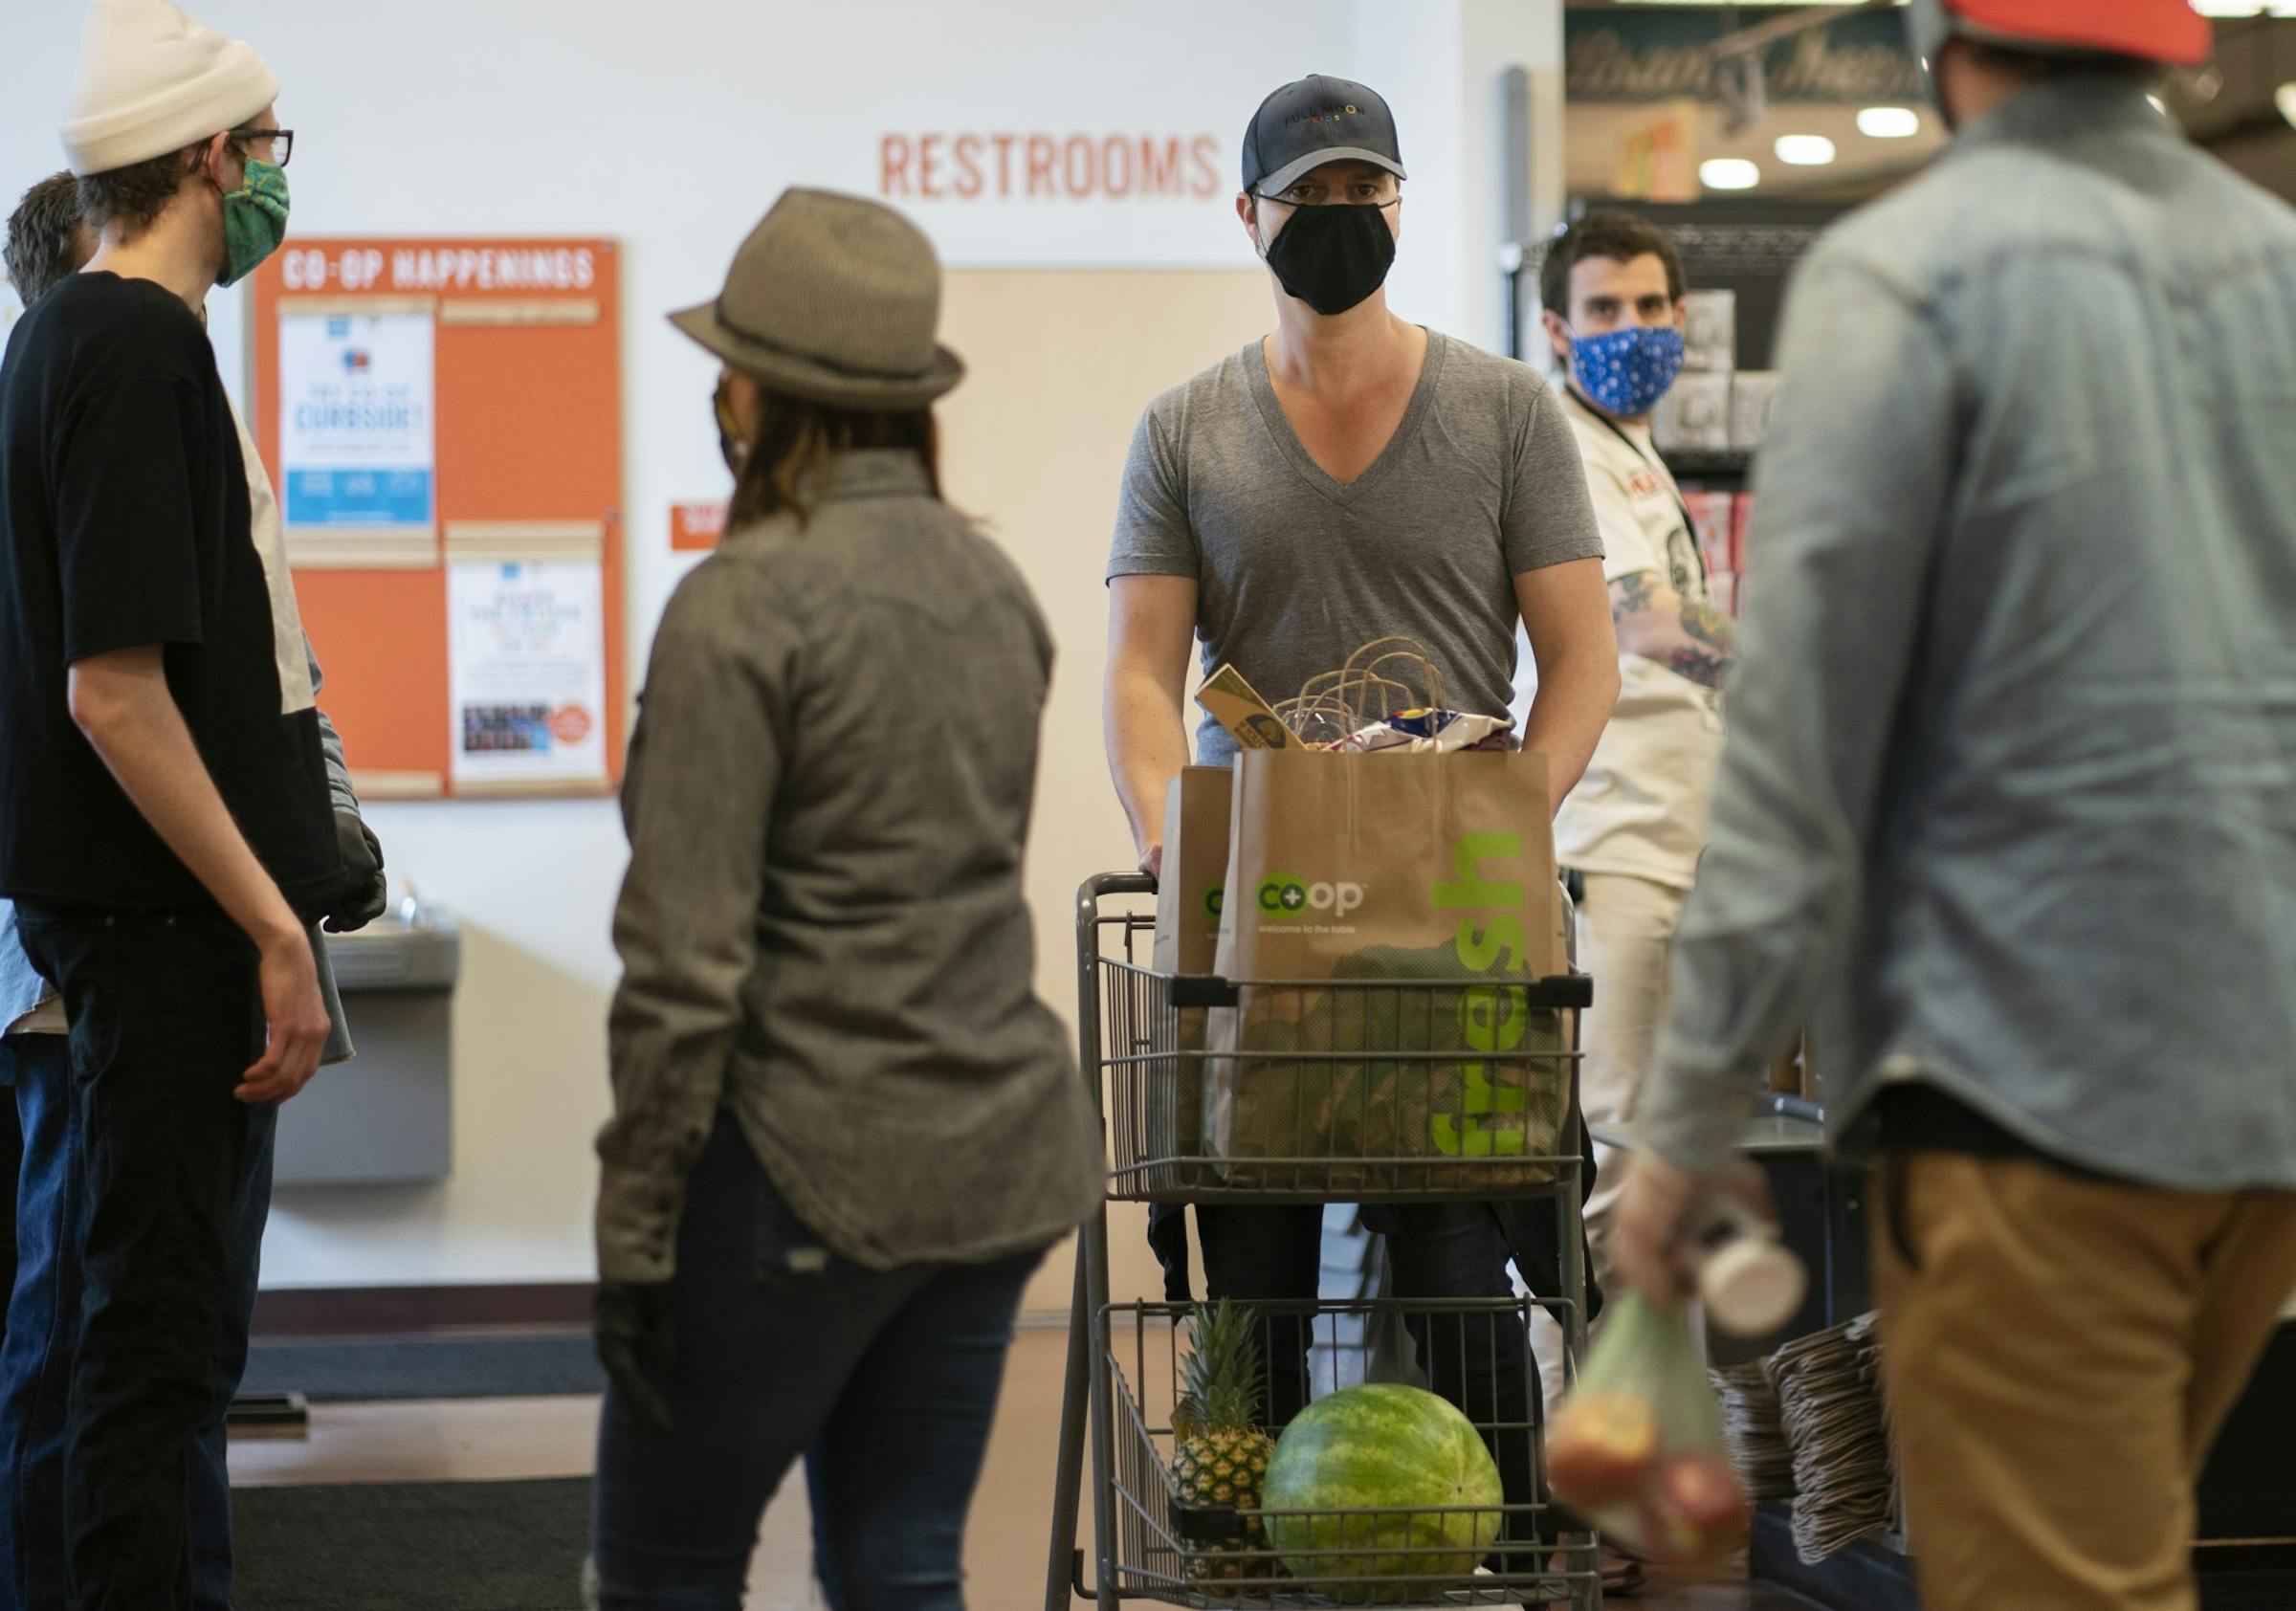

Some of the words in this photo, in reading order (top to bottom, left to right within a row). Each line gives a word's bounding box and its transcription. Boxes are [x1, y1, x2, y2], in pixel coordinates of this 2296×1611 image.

[1285, 105, 1316, 127] FULL
[1322, 102, 1365, 116] MOON
[879, 133, 1220, 199] RESTROOMS
[284, 249, 384, 288] CO-OP
[392, 250, 594, 287] HAPPENINGS
[1259, 925, 1301, 934] welcome
[1303, 925, 1313, 934] to
[1314, 925, 1329, 934] the
[1331, 925, 1356, 934] table
[1430, 830, 1528, 1158] fresh
